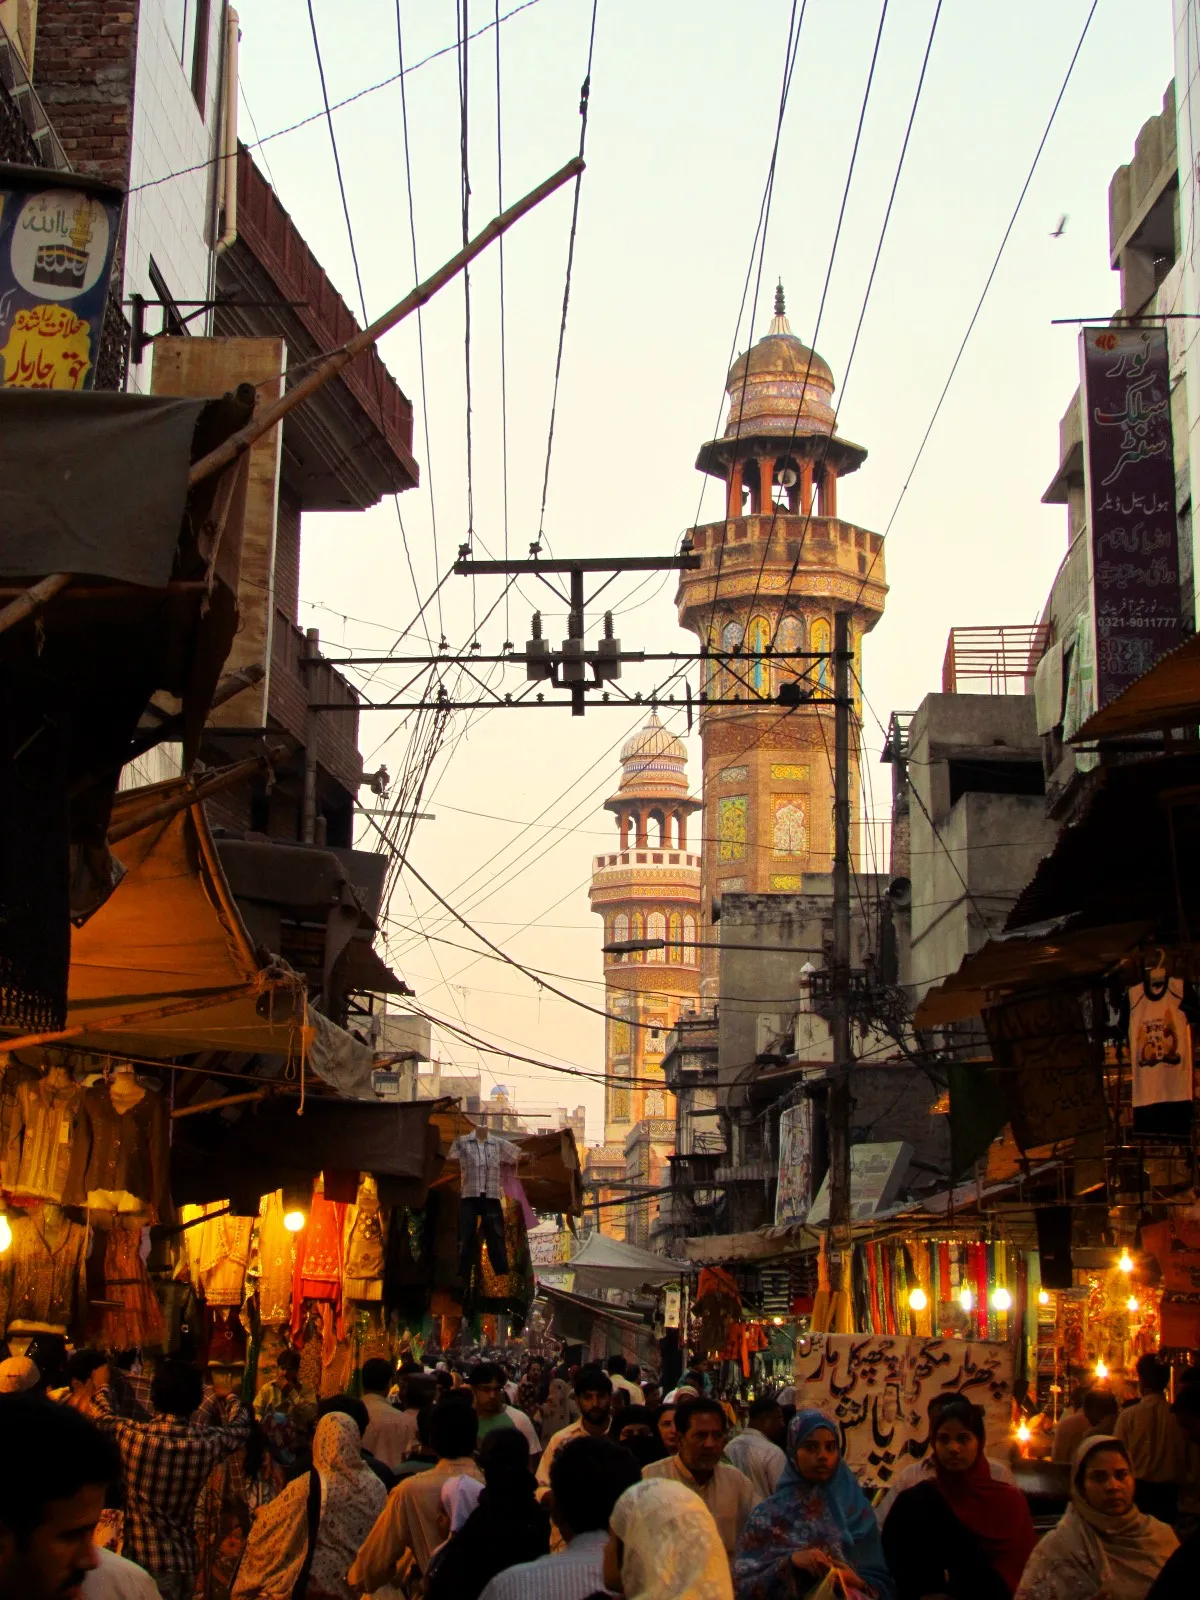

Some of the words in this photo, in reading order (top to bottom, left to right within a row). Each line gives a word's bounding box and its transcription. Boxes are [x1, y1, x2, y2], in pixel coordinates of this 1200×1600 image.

[1106, 331, 1151, 378] نور
[1142, 491, 1170, 515] ہول
[1098, 617, 1178, 628] 0321-9011777
